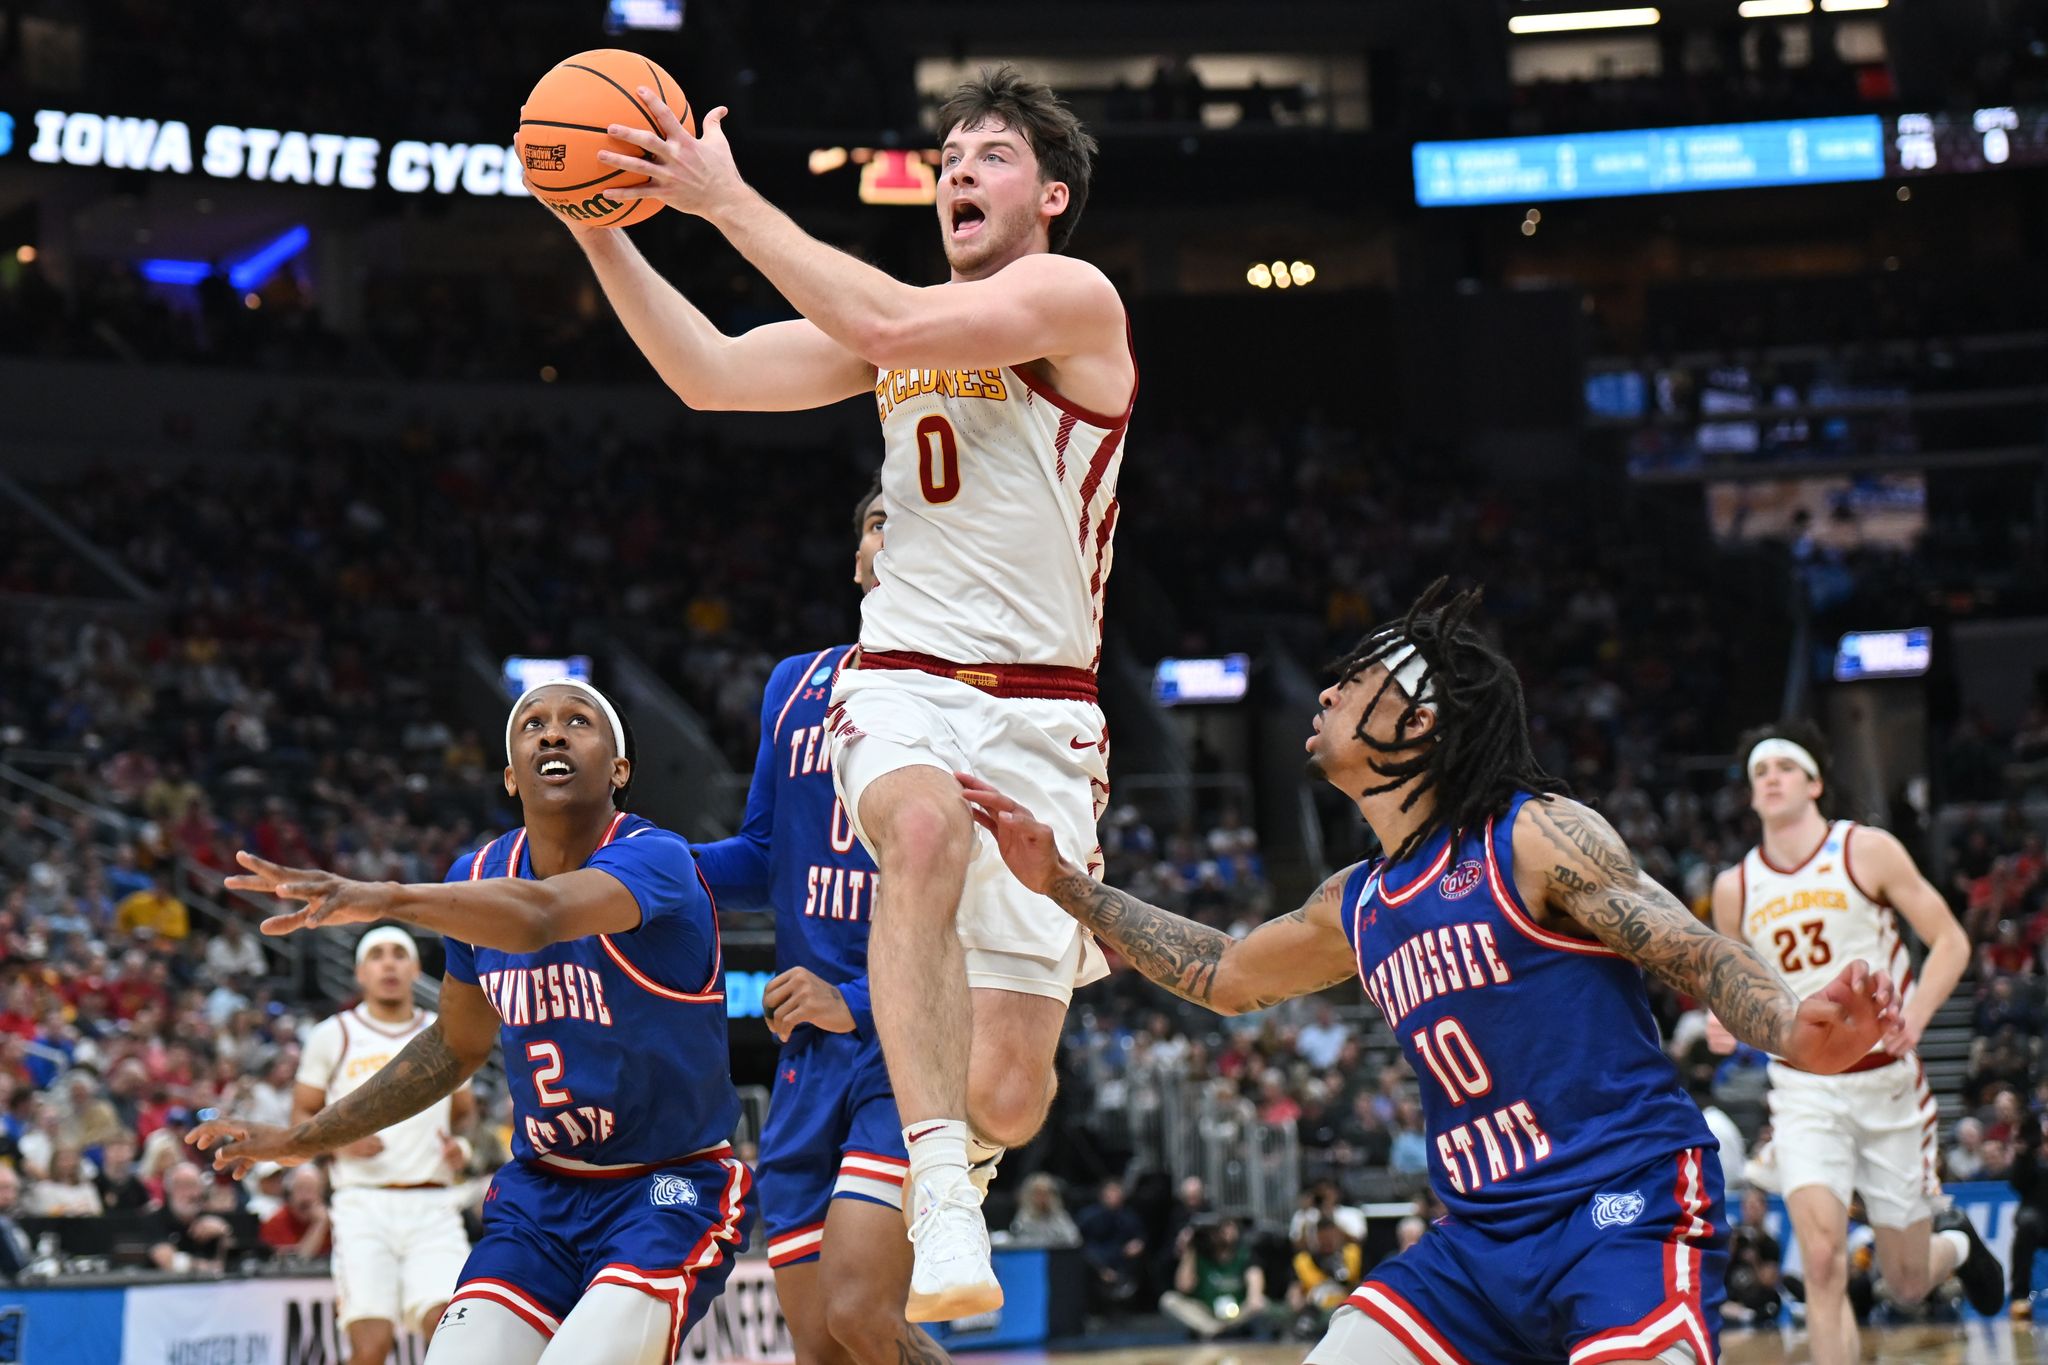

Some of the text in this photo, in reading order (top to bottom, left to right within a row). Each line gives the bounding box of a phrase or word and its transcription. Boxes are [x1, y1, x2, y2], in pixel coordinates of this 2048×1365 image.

[29, 109, 193, 174] IOWA
[202, 124, 380, 190] STATE
[533, 158, 556, 171] MARCH
[552, 193, 624, 220] Wils
[875, 367, 1008, 424] CYCLONES
[916, 413, 960, 505] 0
[831, 797, 857, 855] 0
[1448, 869, 1475, 892] OVC
[1554, 864, 1597, 896] The
[1772, 917, 1833, 974] 23
[1368, 921, 1512, 1030] TENNESSEE
[524, 1038, 576, 1108] 2
[1411, 1014, 1493, 1107] 10
[524, 1105, 618, 1157] STATE
[1434, 1099, 1552, 1196] STATE
